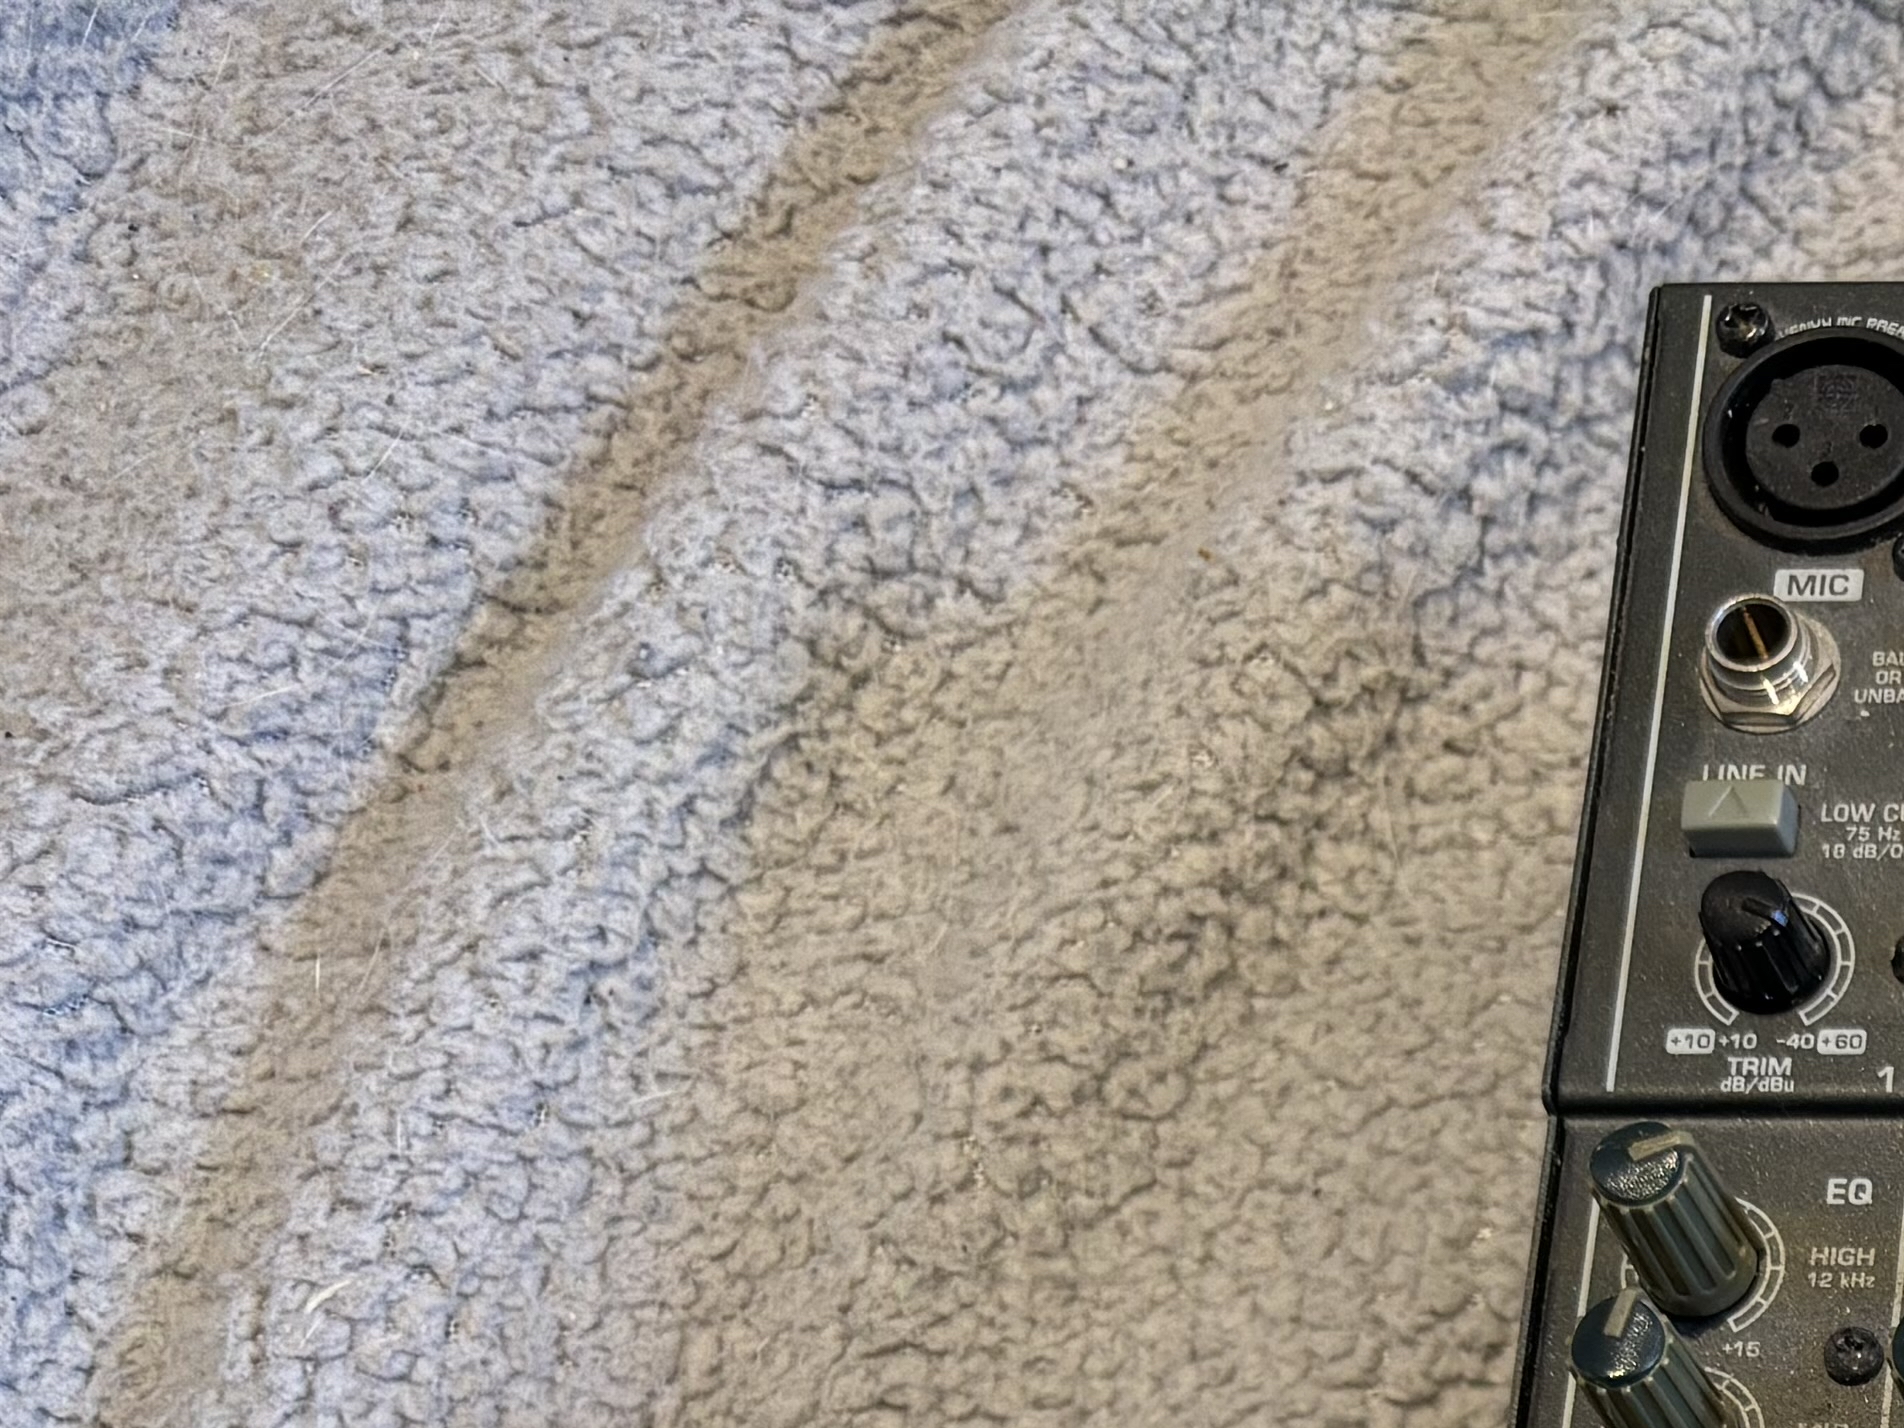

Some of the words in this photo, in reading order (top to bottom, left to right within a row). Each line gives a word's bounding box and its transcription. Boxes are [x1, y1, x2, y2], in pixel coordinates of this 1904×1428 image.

[1786, 574, 1850, 596] MIC
[1874, 670, 1902, 685] OR
[1820, 803, 1876, 822] LOW
[1727, 1056, 1792, 1076] TRIM
[1720, 1076, 1795, 1094] dB/dBu
[1877, 1066, 1895, 1092] 1
[1826, 1178, 1873, 1206] EQ
